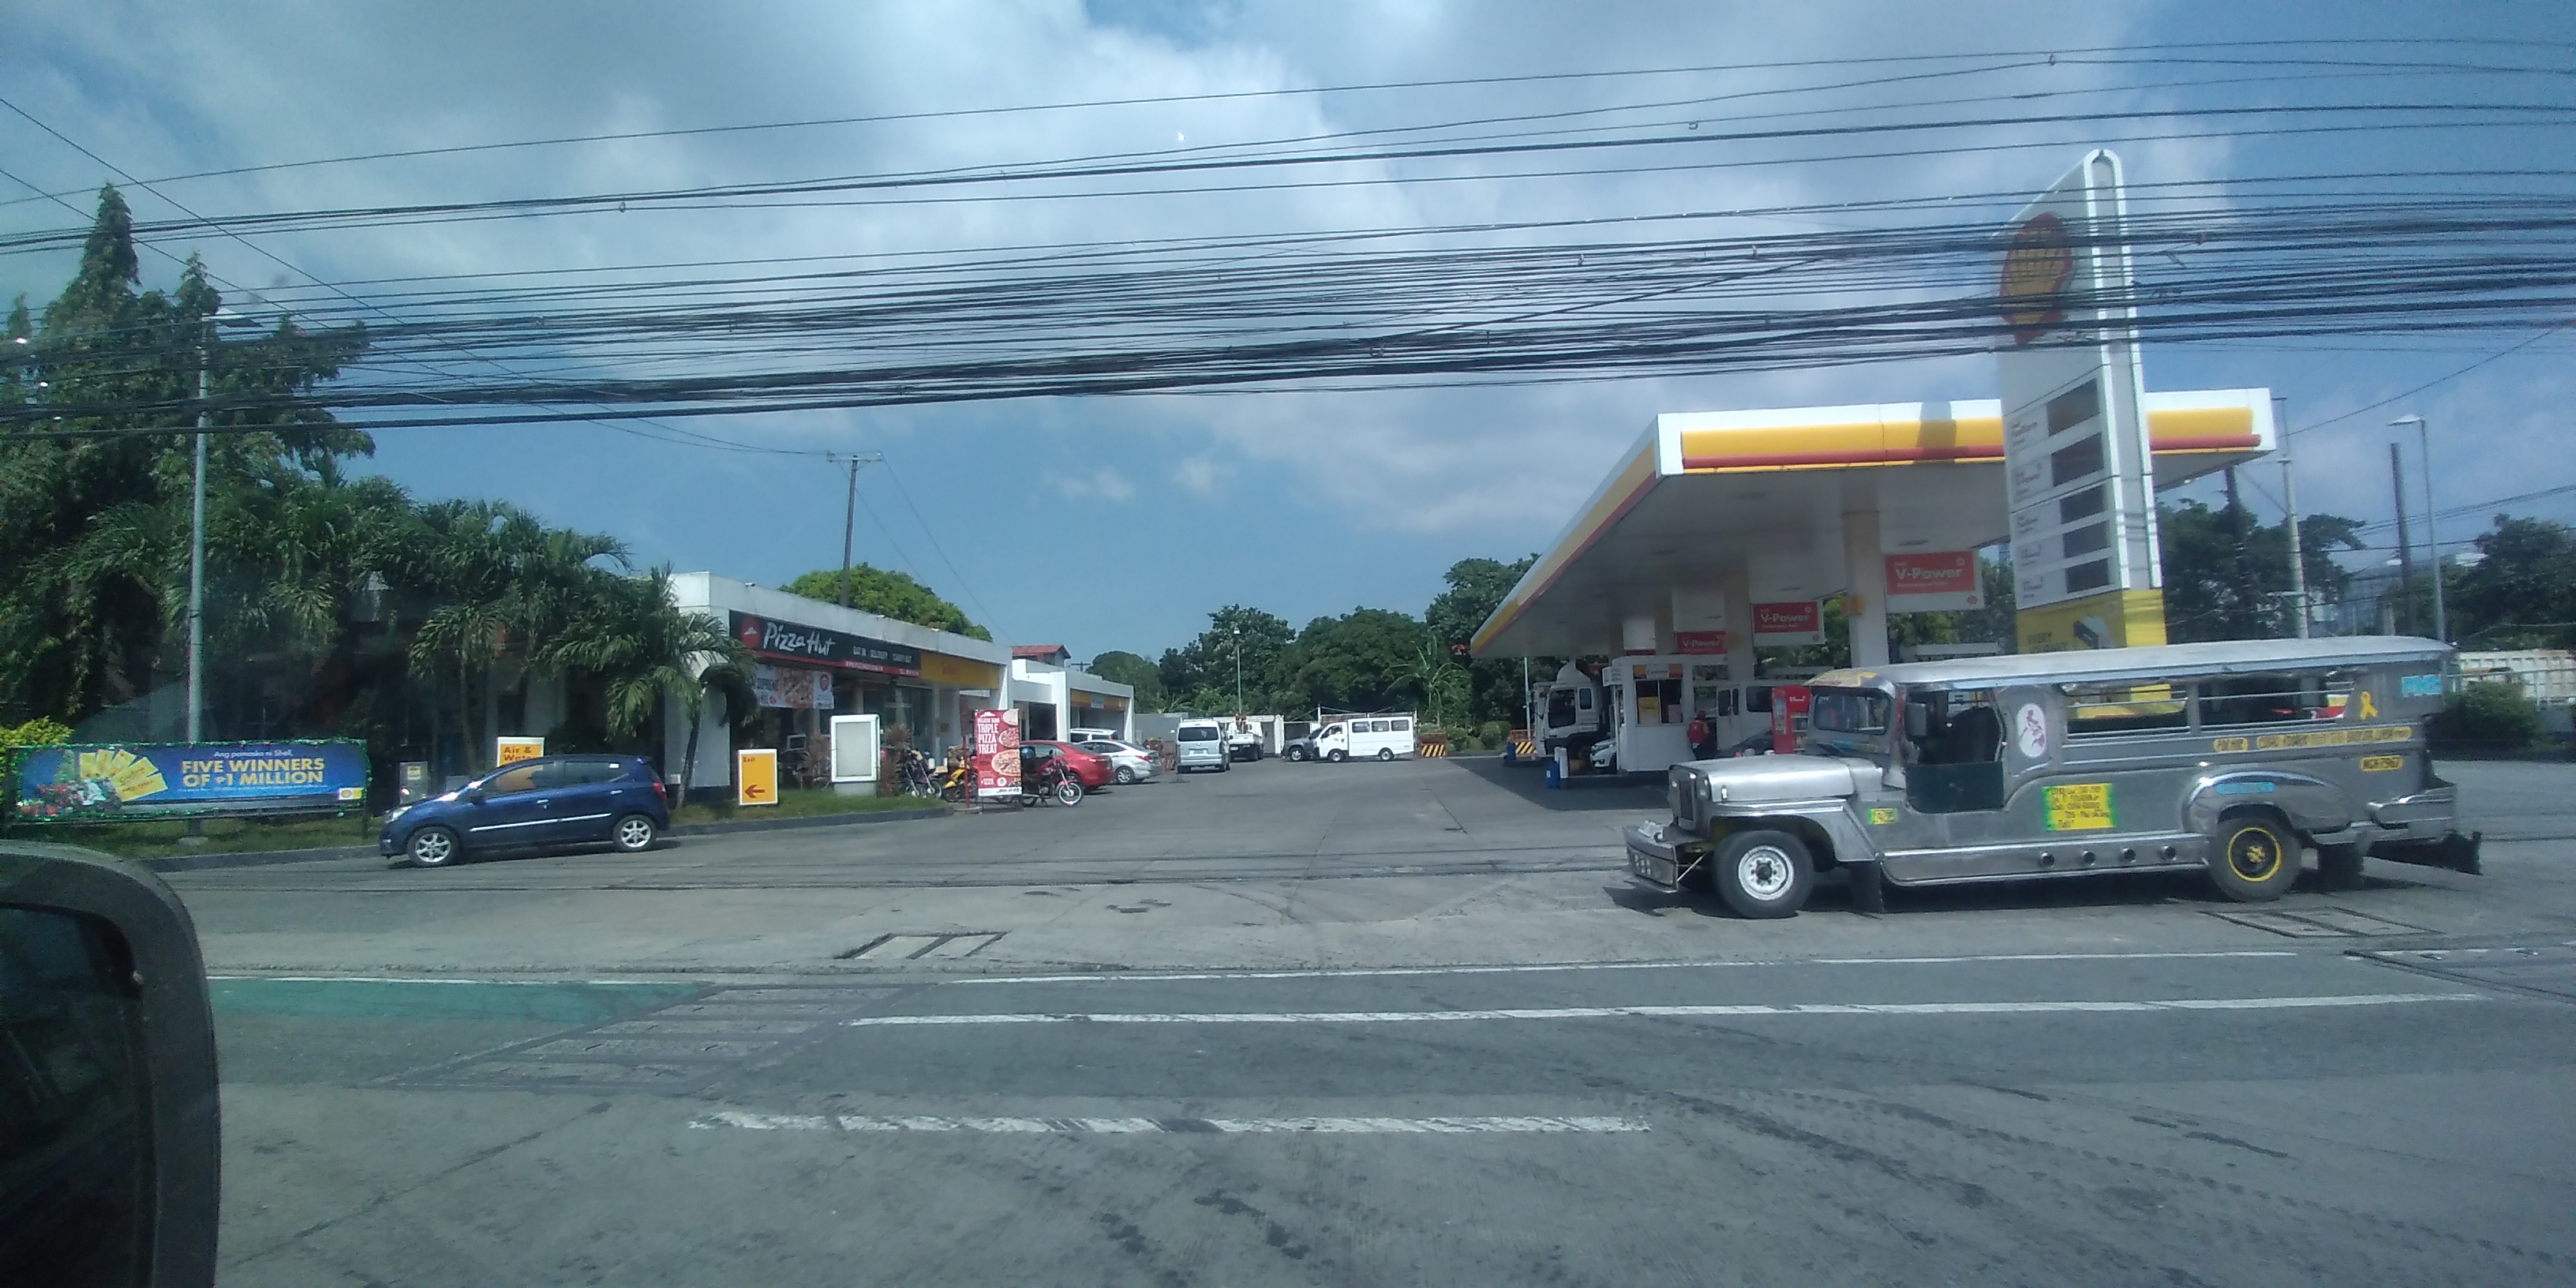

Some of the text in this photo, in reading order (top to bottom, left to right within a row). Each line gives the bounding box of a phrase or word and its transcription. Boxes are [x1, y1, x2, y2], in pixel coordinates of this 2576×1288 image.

[1896, 567, 1962, 579] V-Power
[1761, 613, 1810, 622] V-Power
[763, 621, 836, 656] Pizza Hut
[978, 723, 998, 734] TRIPLE
[979, 734, 997, 743] PIZZA
[979, 743, 998, 754] TREAT
[182, 758, 325, 773] FIVE WINNERS
[182, 773, 211, 788] OF
[239, 771, 324, 786] MILLION
